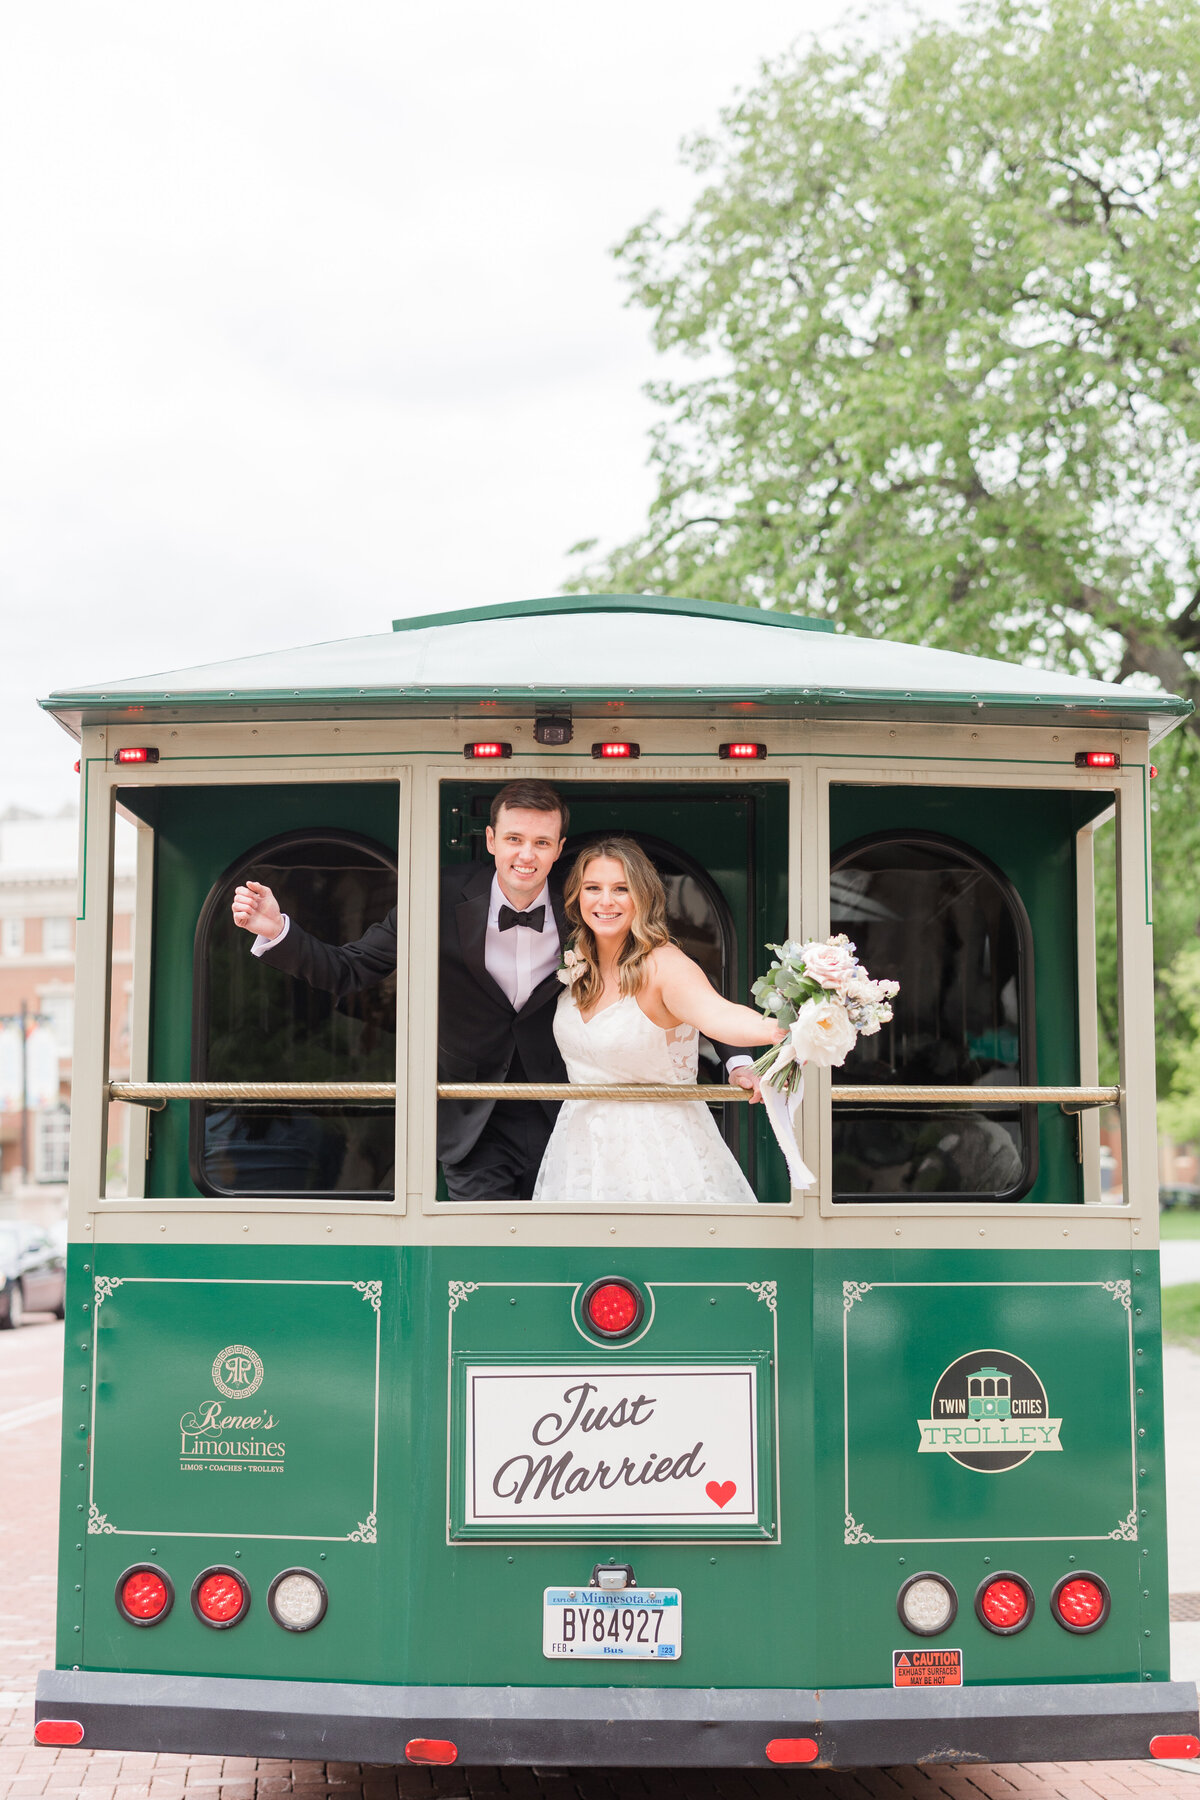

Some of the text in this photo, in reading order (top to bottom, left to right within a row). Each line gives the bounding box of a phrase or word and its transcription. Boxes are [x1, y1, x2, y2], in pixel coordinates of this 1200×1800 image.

[532, 1382, 657, 1446] Just
[938, 1398, 1043, 1415] TWIN CITIES
[180, 1400, 280, 1438] Renee's
[923, 1426, 1057, 1445] TROLLEY
[180, 1433, 286, 1457] Limousines
[180, 1463, 285, 1473] LIMOS COACHES TROLLEYS
[492, 1441, 707, 1505] Married
[581, 1592, 662, 1604] Minnesota.com
[562, 1607, 664, 1643] BY84927
[552, 1642, 567, 1653] FEB
[603, 1646, 624, 1654] Bus
[912, 1652, 959, 1666] CAUTION
[927, 1667, 958, 1676] SURFACES
[910, 1676, 946, 1684] MAY BE HOT
